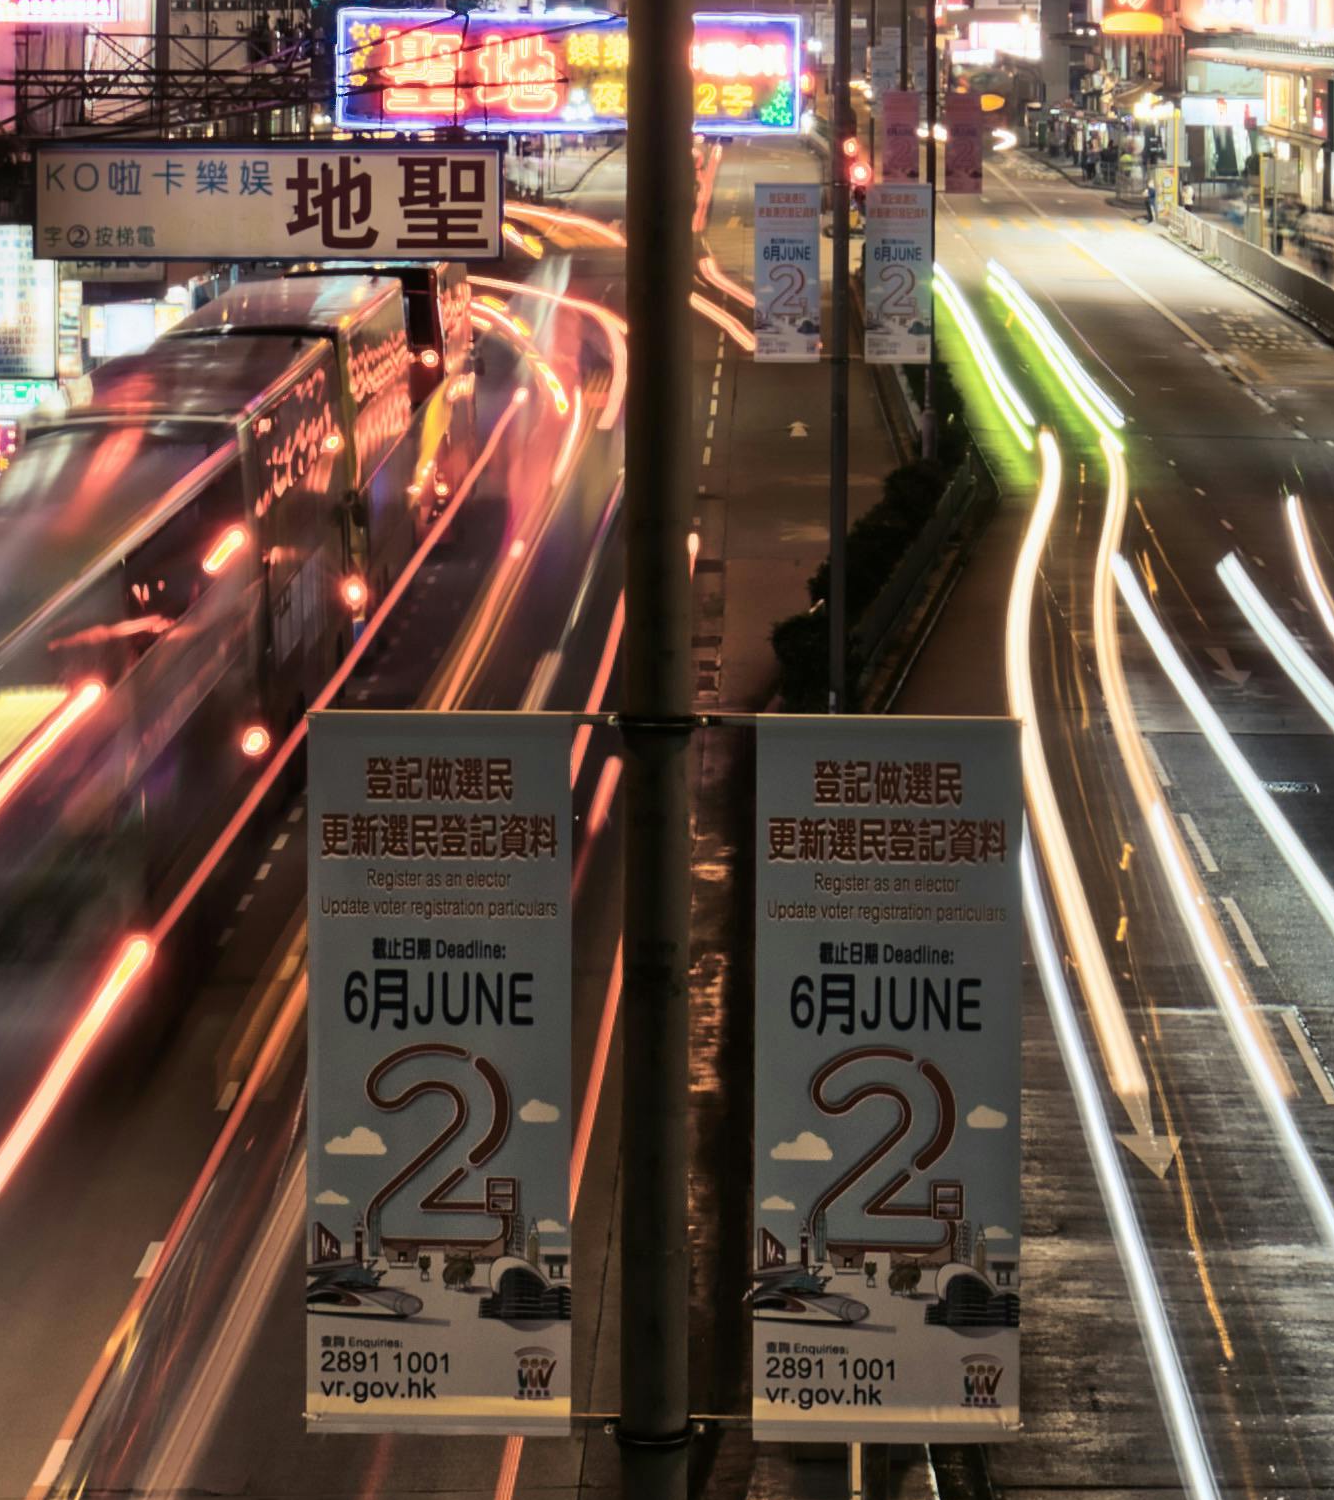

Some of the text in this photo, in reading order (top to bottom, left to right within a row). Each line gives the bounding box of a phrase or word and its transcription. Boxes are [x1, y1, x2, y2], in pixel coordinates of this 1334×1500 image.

[381, 29, 558, 115] 聖地
[366, 756, 515, 802] 登記做選民
[814, 760, 964, 807] 登記做選民
[321, 812, 559, 859] 更新選民登記資料
[768, 816, 1007, 864] 更新選民登記資料
[367, 869, 511, 891] Register as an elector
[814, 873, 960, 895] Register as an elector
[321, 898, 558, 920] Update voter registration particulars
[767, 902, 1007, 925] Update voter registration particulars
[372, 937, 507, 961] 截止日期 Deadline:
[819, 942, 954, 966] 截止日期 Deadline:
[344, 968, 534, 1031] 6月JUNE
[790, 973, 982, 1036] 6月JUNE
[348, 1336, 404, 1350] Enquiries:
[793, 1342, 850, 1355] Enquiries:
[320, 1351, 450, 1374] 2891 1001
[766, 1356, 896, 1380] 2891 1001
[320, 1378, 437, 1403] vr.gov.hk
[765, 1383, 883, 1410] vr.gov.hk
